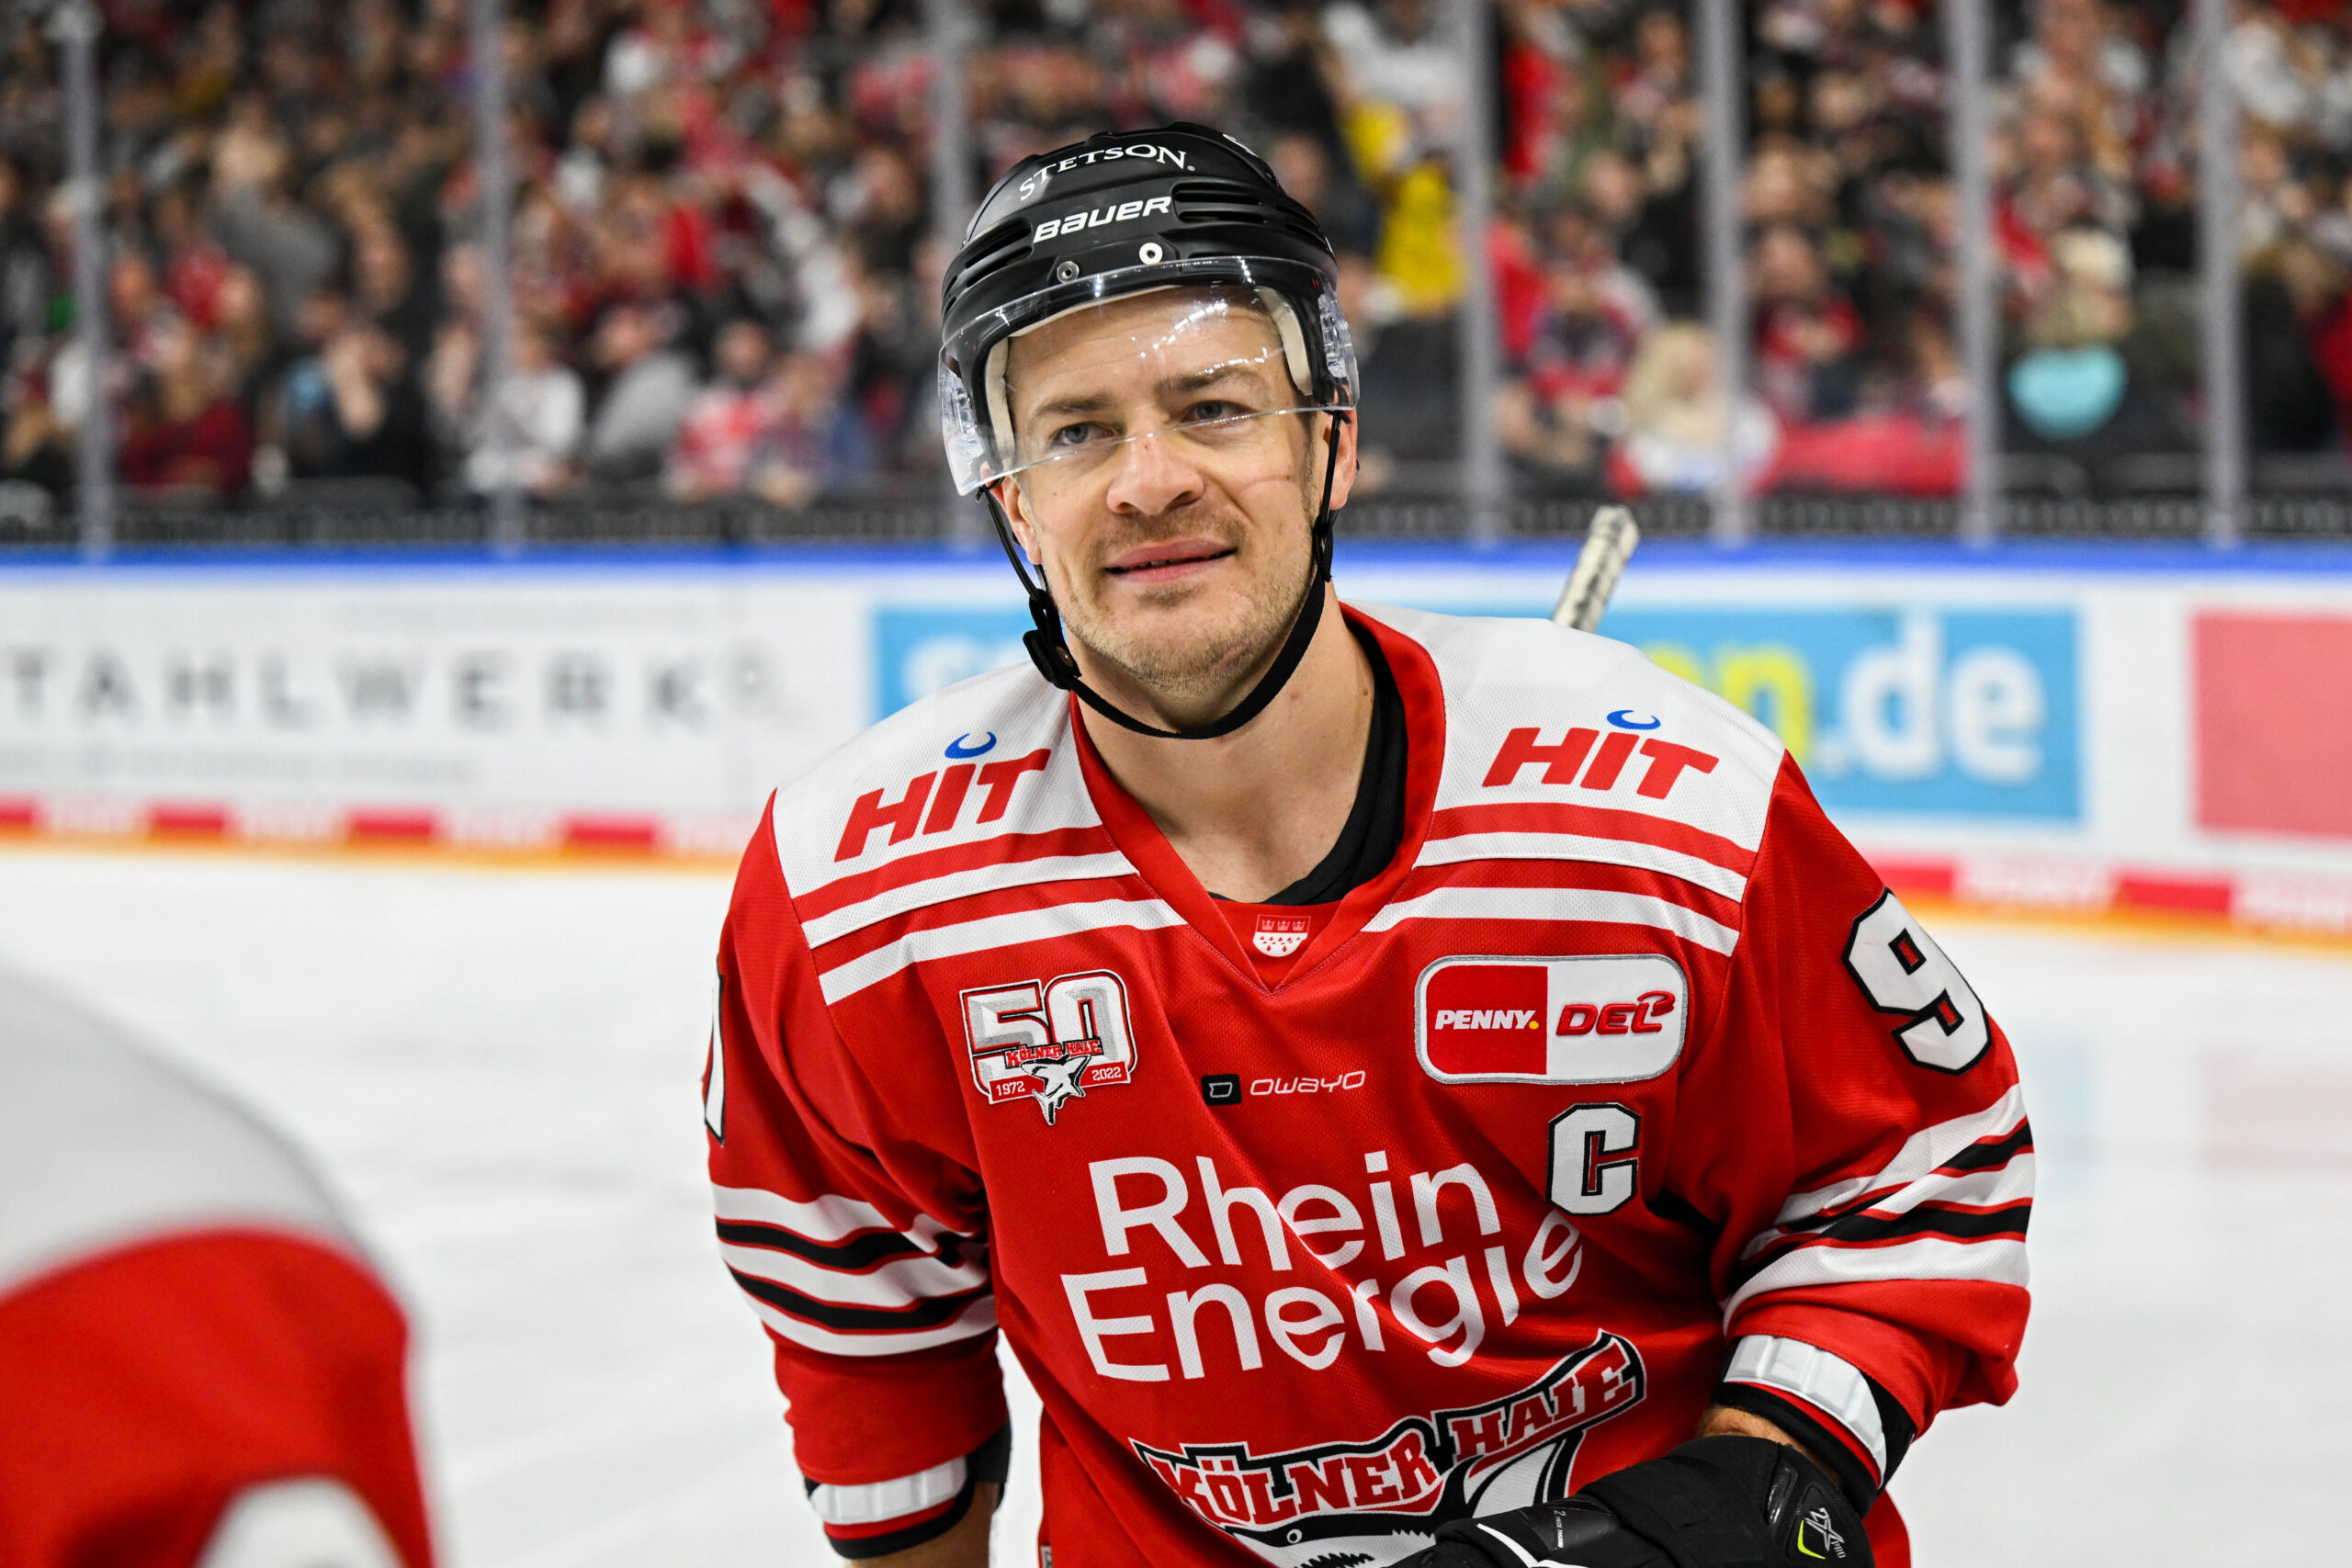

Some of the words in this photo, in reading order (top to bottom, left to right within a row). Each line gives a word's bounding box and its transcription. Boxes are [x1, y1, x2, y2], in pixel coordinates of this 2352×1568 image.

[1019, 143, 1188, 202] STETSON
[1032, 196, 1172, 244] BAUER
[833, 748, 1052, 863] HIT
[1481, 727, 1720, 800] HIT
[960, 970, 1137, 1097] 50
[1064, 1039, 1102, 1057] HAIE
[1091, 1066, 1123, 1082] 2022
[995, 1080, 1026, 1097] 1972
[1547, 1102, 1642, 1216] C
[1088, 1149, 1502, 1271] Rhein
[1059, 1209, 1584, 1382] Energie
[1148, 1431, 1444, 1527] KÖLNER
[1451, 1337, 1636, 1463] HAIE
